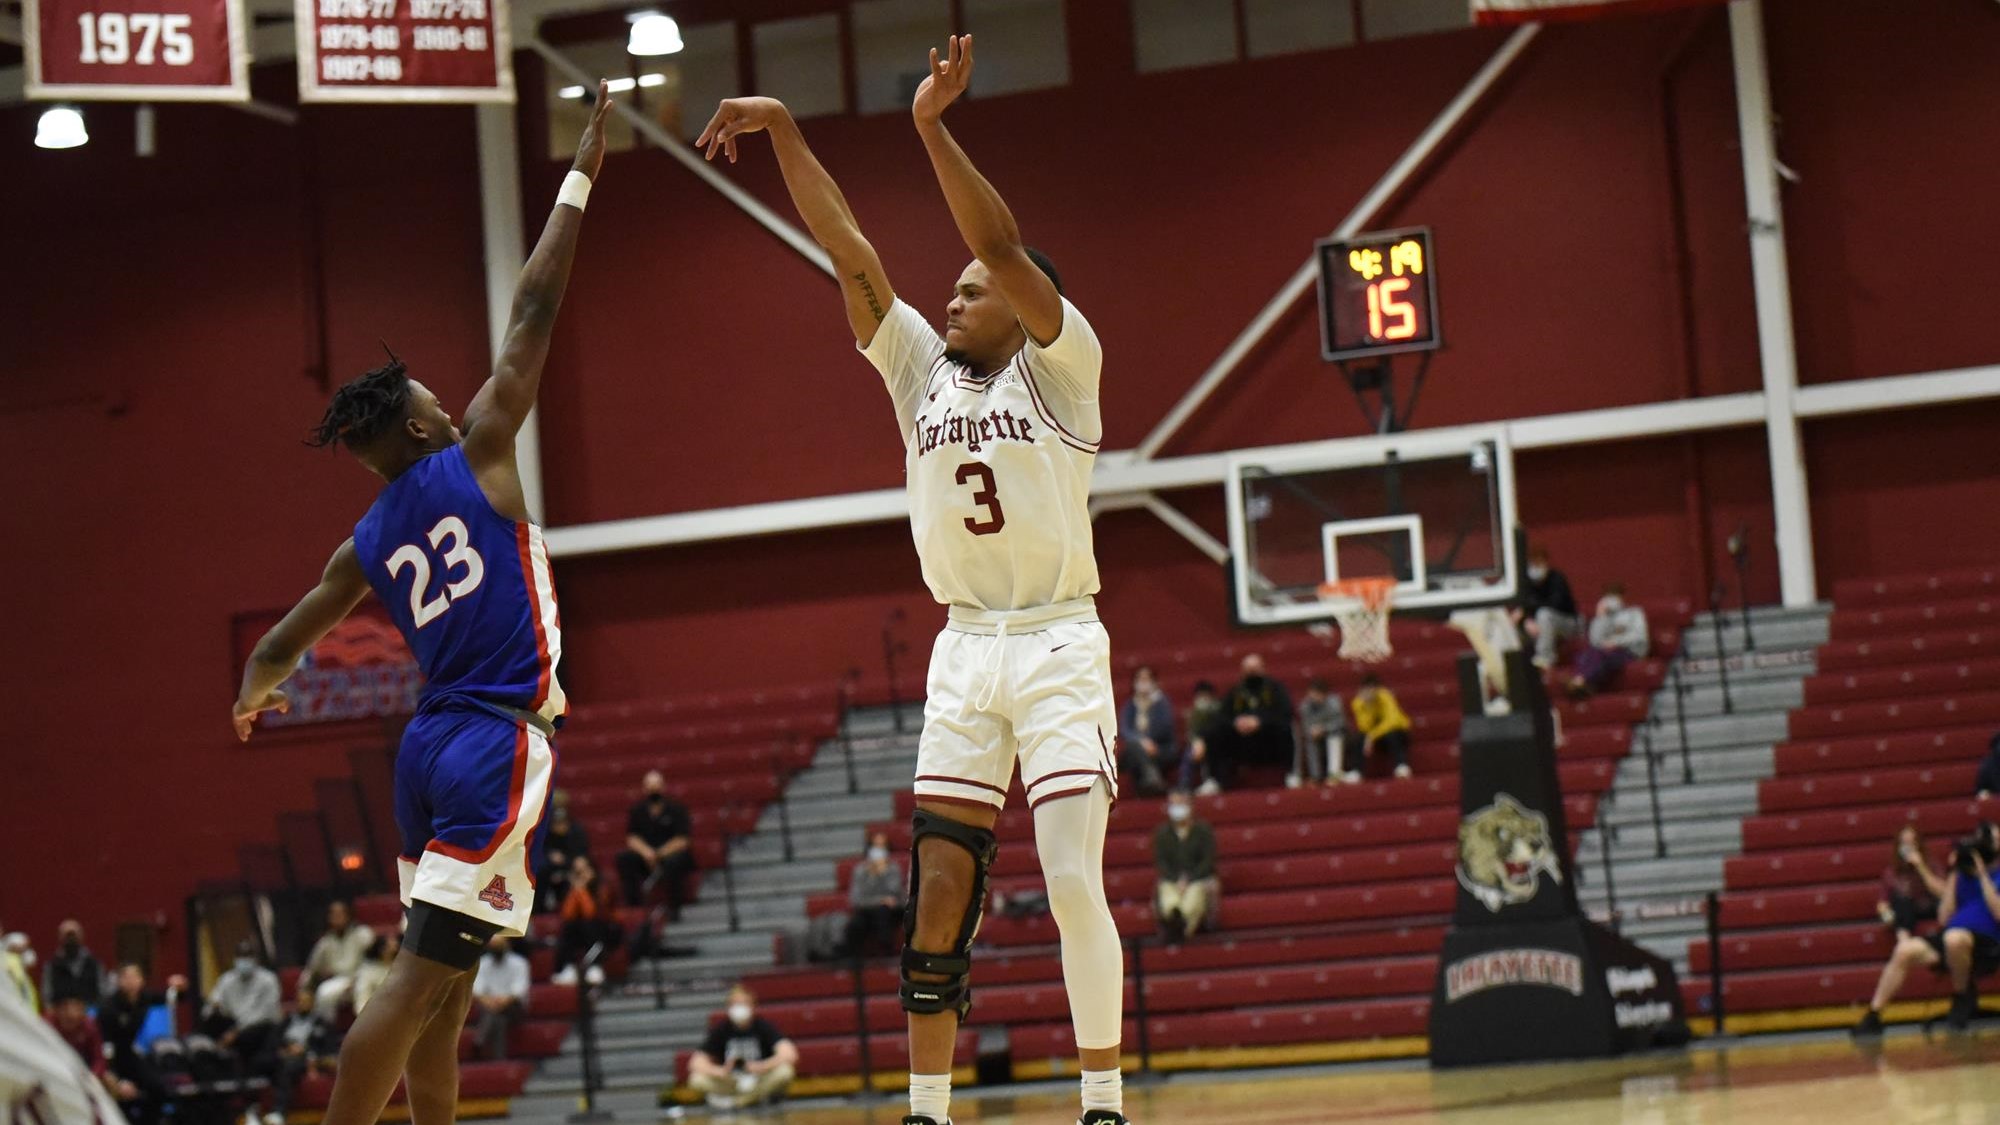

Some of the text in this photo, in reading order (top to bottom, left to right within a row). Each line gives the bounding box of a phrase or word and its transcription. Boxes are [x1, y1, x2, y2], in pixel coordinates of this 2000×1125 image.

[79, 12, 194, 66] 1975
[1349, 240, 1423, 280] 4:19
[1366, 277, 1417, 339] 15
[915, 407, 1036, 458] Lafayette
[954, 461, 1006, 536] 3
[384, 515, 485, 630] 23
[1446, 949, 1584, 1002] LAFAYETTE
